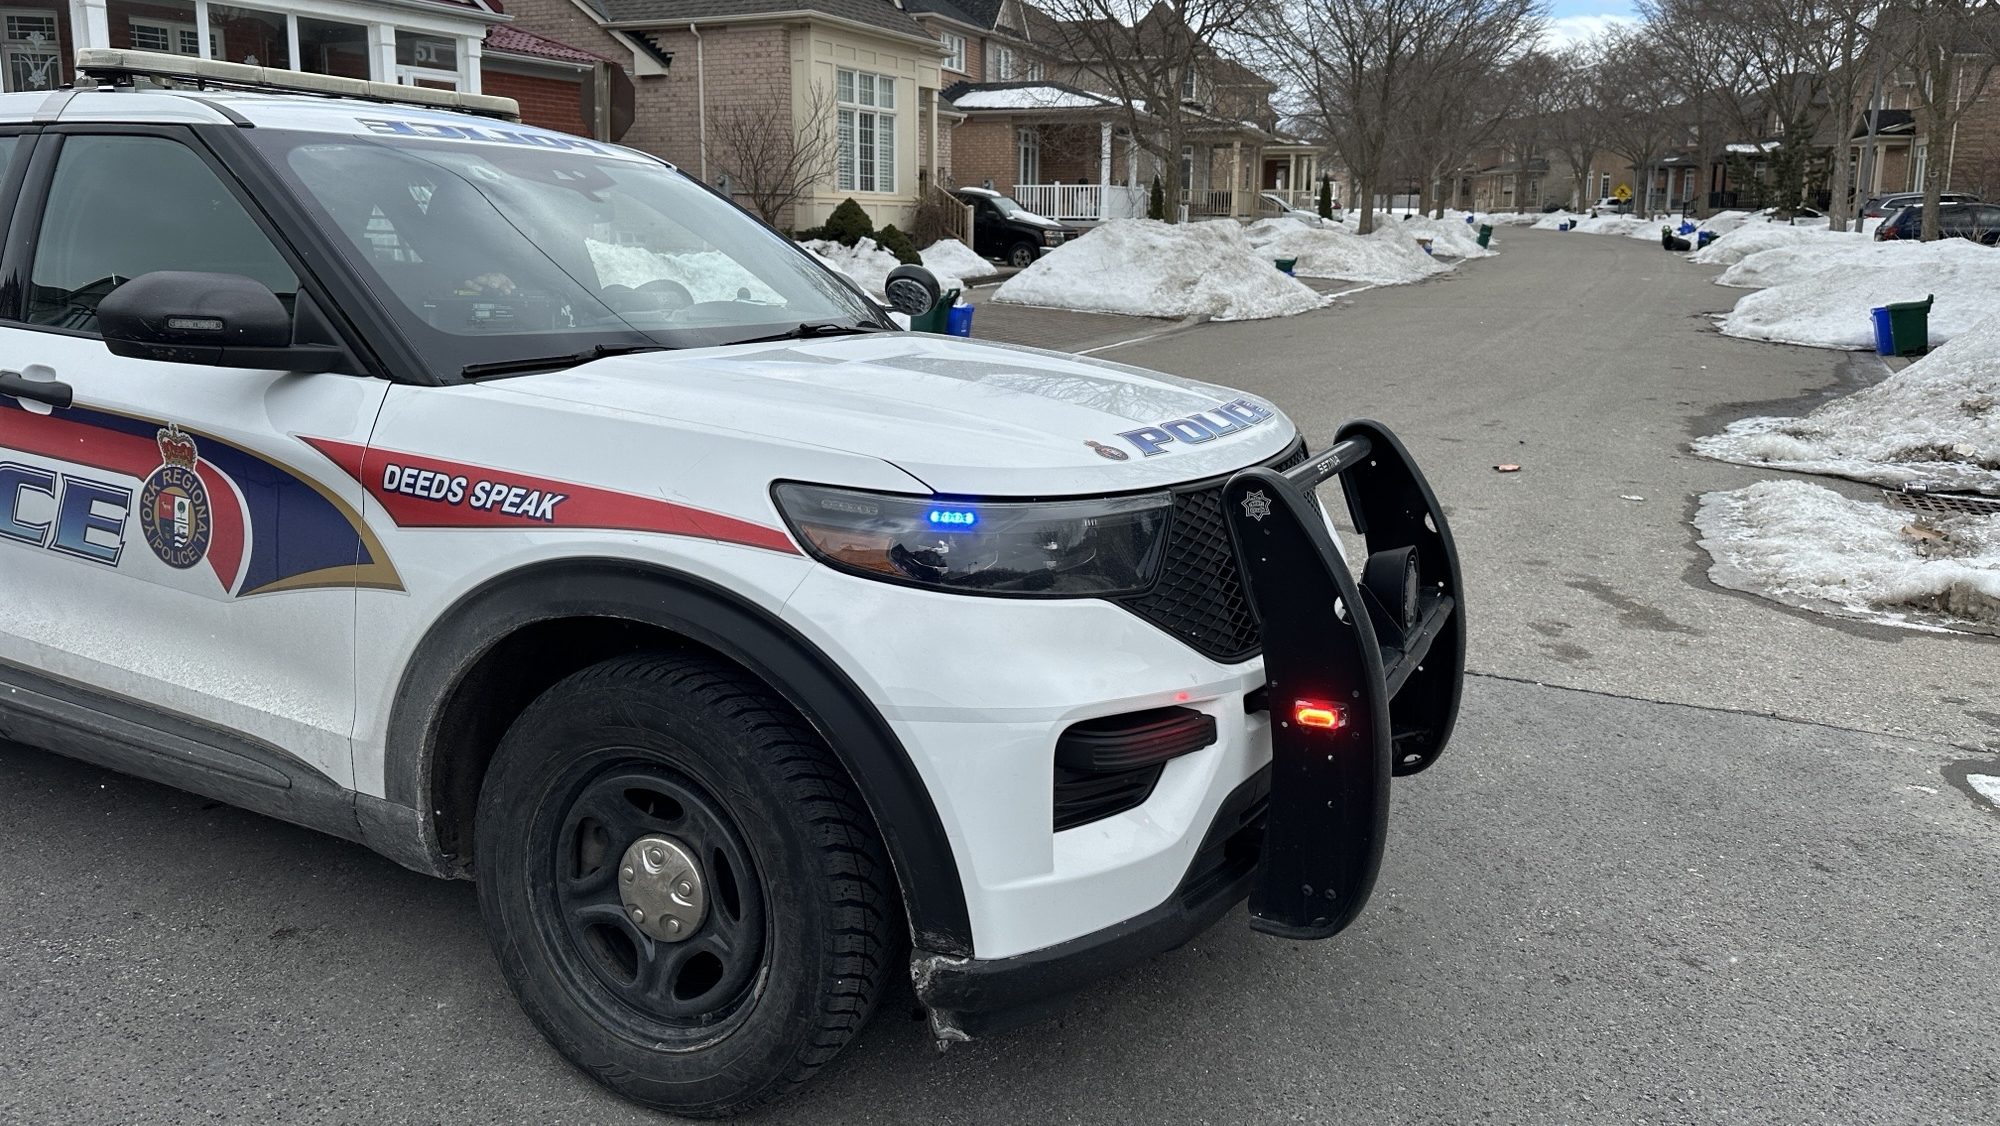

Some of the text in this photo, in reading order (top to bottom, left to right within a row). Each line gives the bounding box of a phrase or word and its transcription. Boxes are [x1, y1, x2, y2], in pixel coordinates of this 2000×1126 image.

[415, 41, 438, 62] 51
[1115, 398, 1275, 457] POLICE
[1317, 455, 1340, 475] SETINA
[142, 469, 208, 543] YORK REGIONAL
[383, 464, 566, 520] DEEDS SPEAK
[154, 538, 198, 565] POLICE
